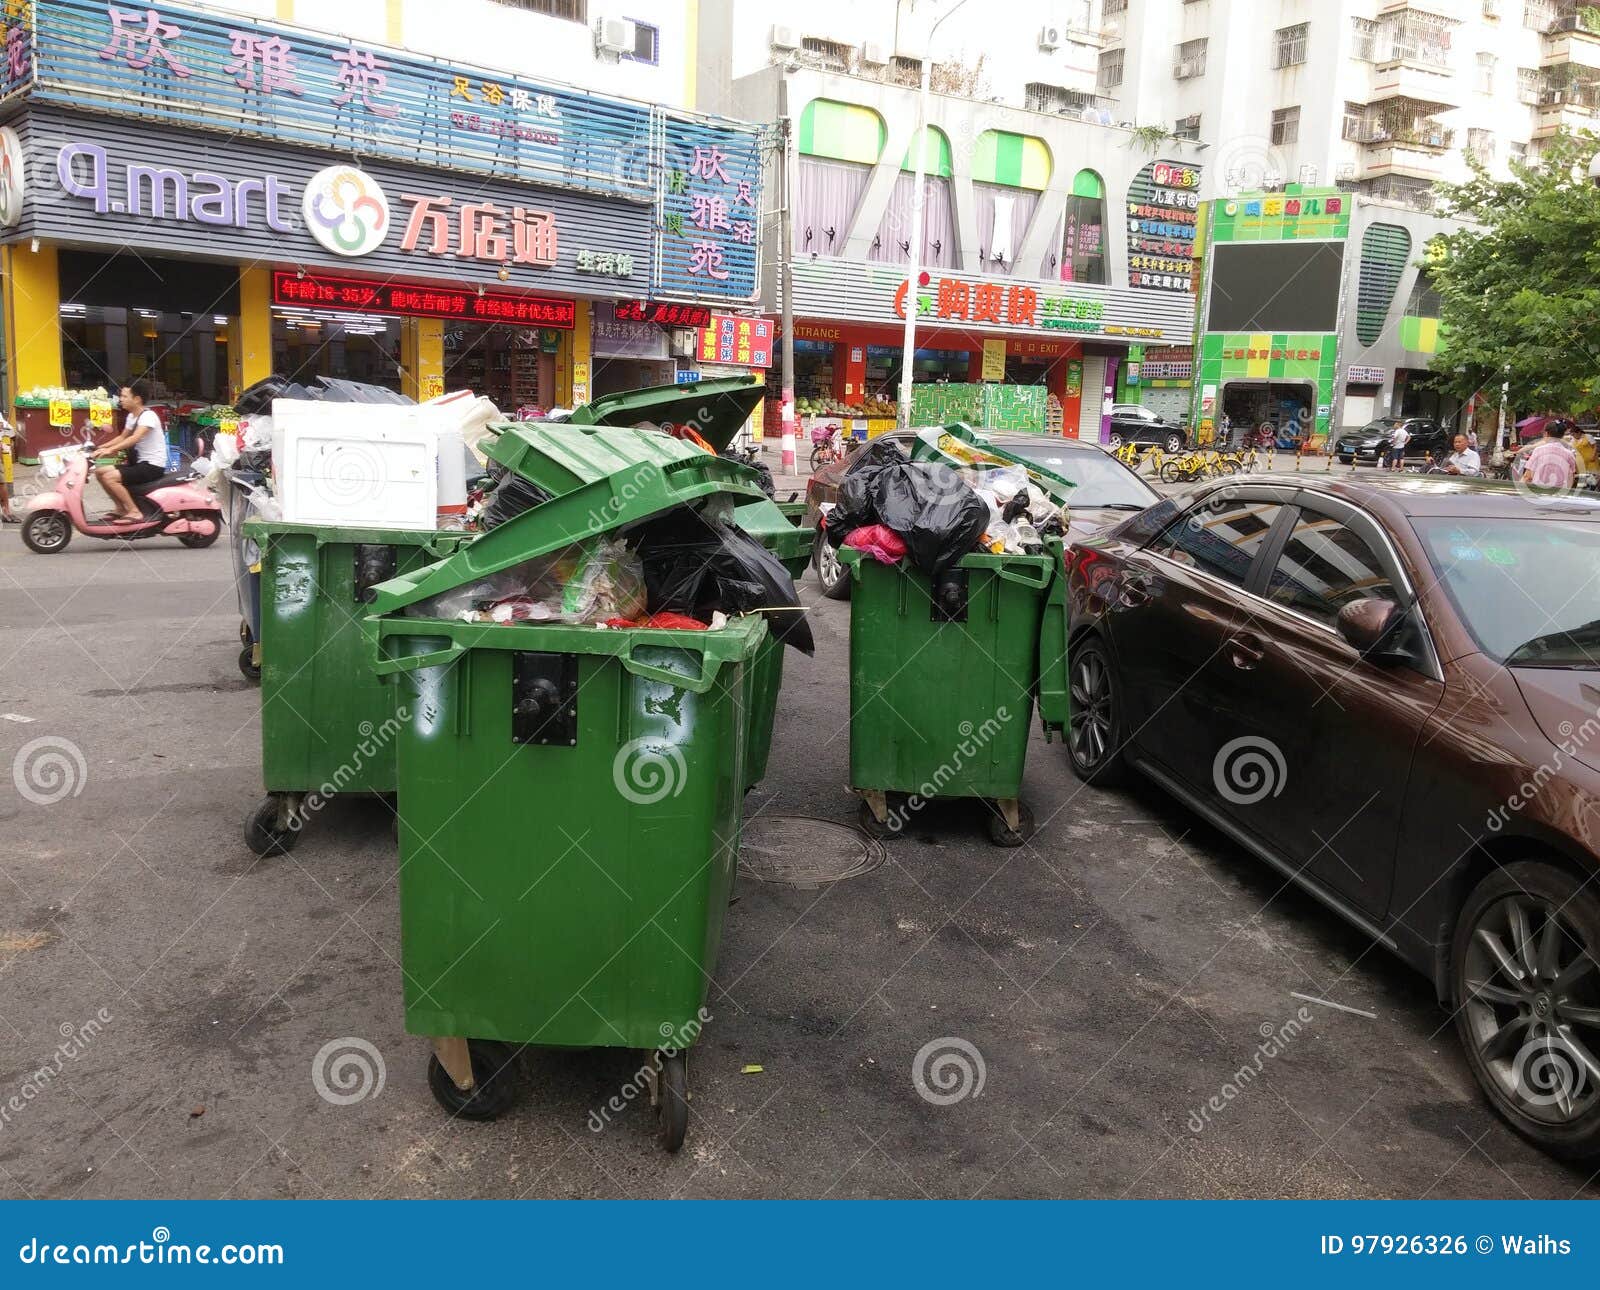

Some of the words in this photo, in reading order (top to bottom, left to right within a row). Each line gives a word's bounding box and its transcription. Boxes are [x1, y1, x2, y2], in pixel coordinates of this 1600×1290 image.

[100, 7, 401, 119] 欣雅苑
[57, 142, 293, 233] q.mart
[687, 144, 732, 281] 欣雅苑
[400, 193, 559, 267] 万店通
[576, 249, 634, 277] 生活馆
[937, 277, 1037, 326] 购爽快
[793, 326, 841, 340] NTRANCE
[1040, 344, 1059, 353] EXIT
